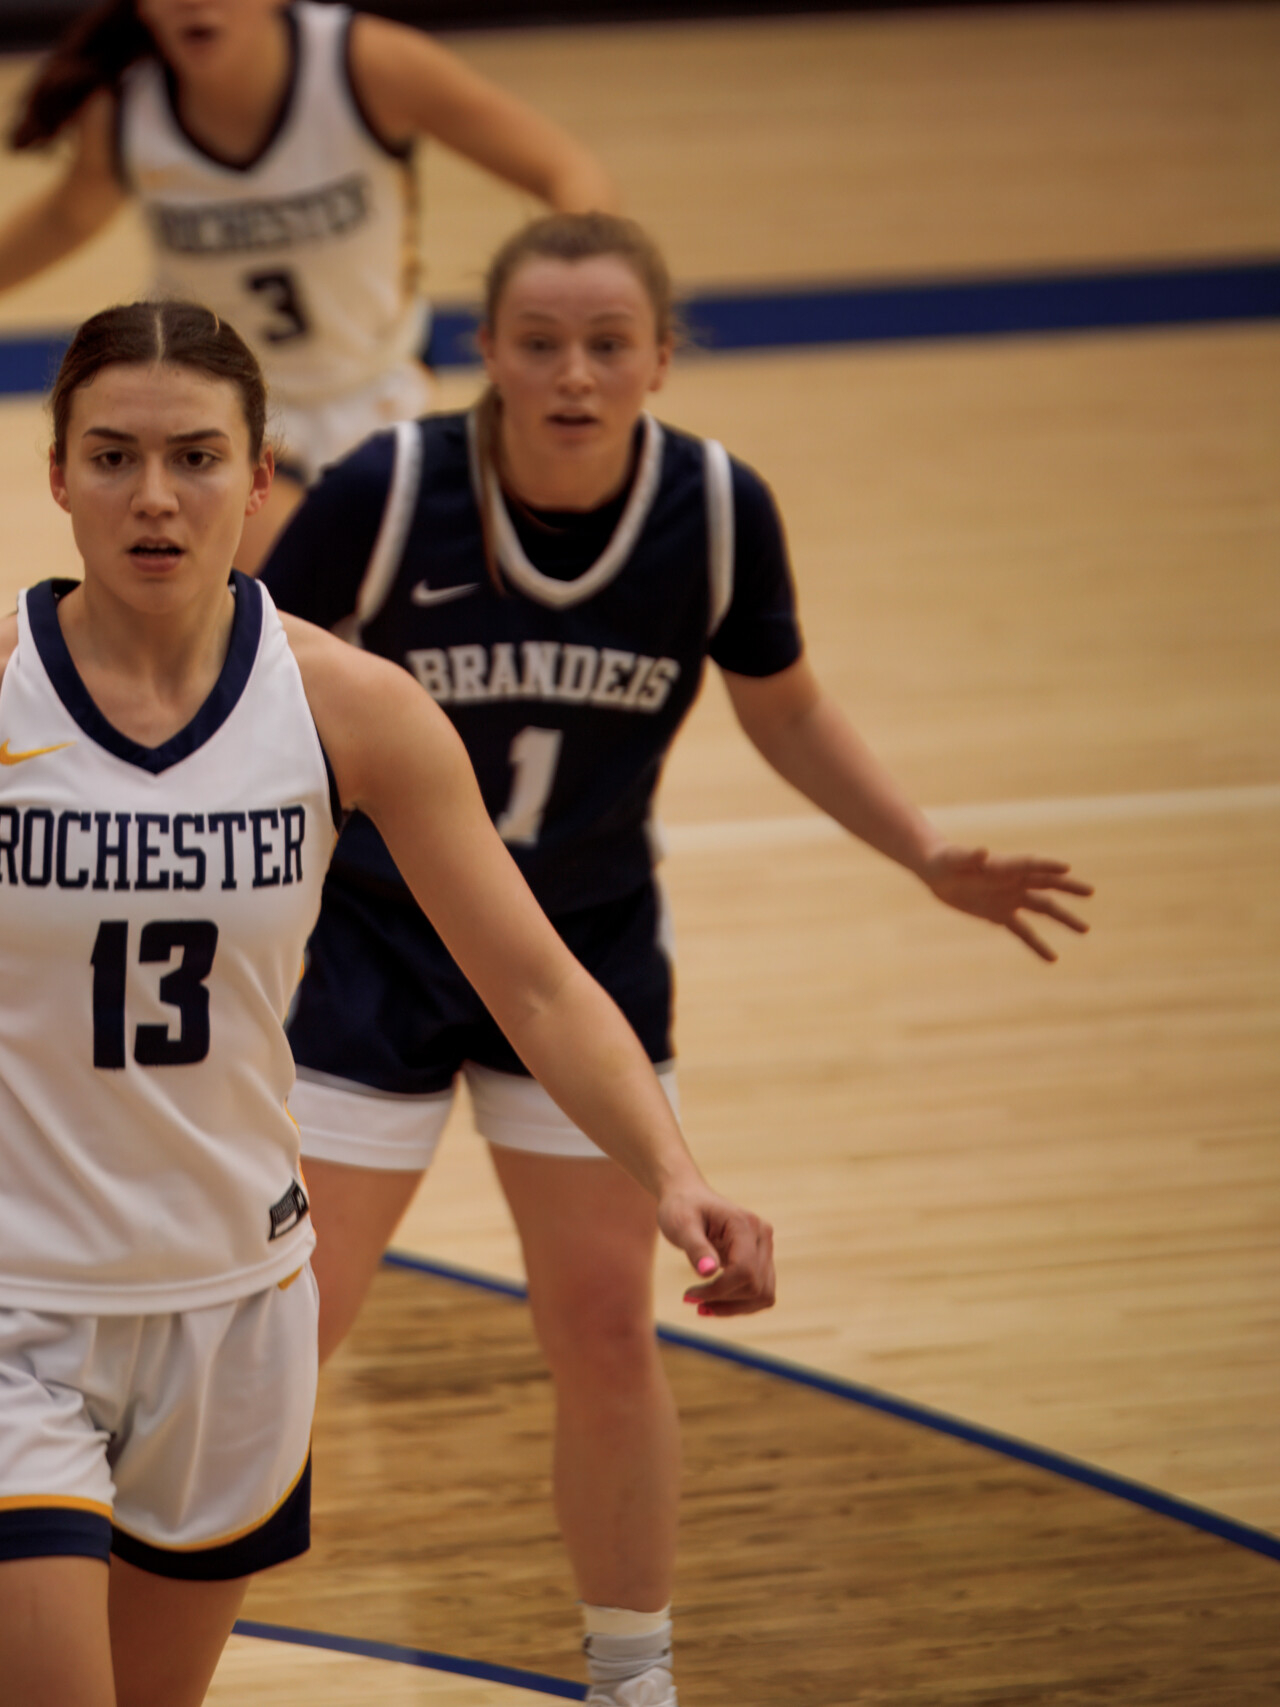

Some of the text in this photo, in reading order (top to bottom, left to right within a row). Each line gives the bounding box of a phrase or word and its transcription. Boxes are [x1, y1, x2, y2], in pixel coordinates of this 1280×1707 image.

[244, 268, 309, 346] 3
[407, 641, 680, 714] BRANDEIS
[497, 726, 563, 846] 1
[90, 918, 219, 1070] 13
